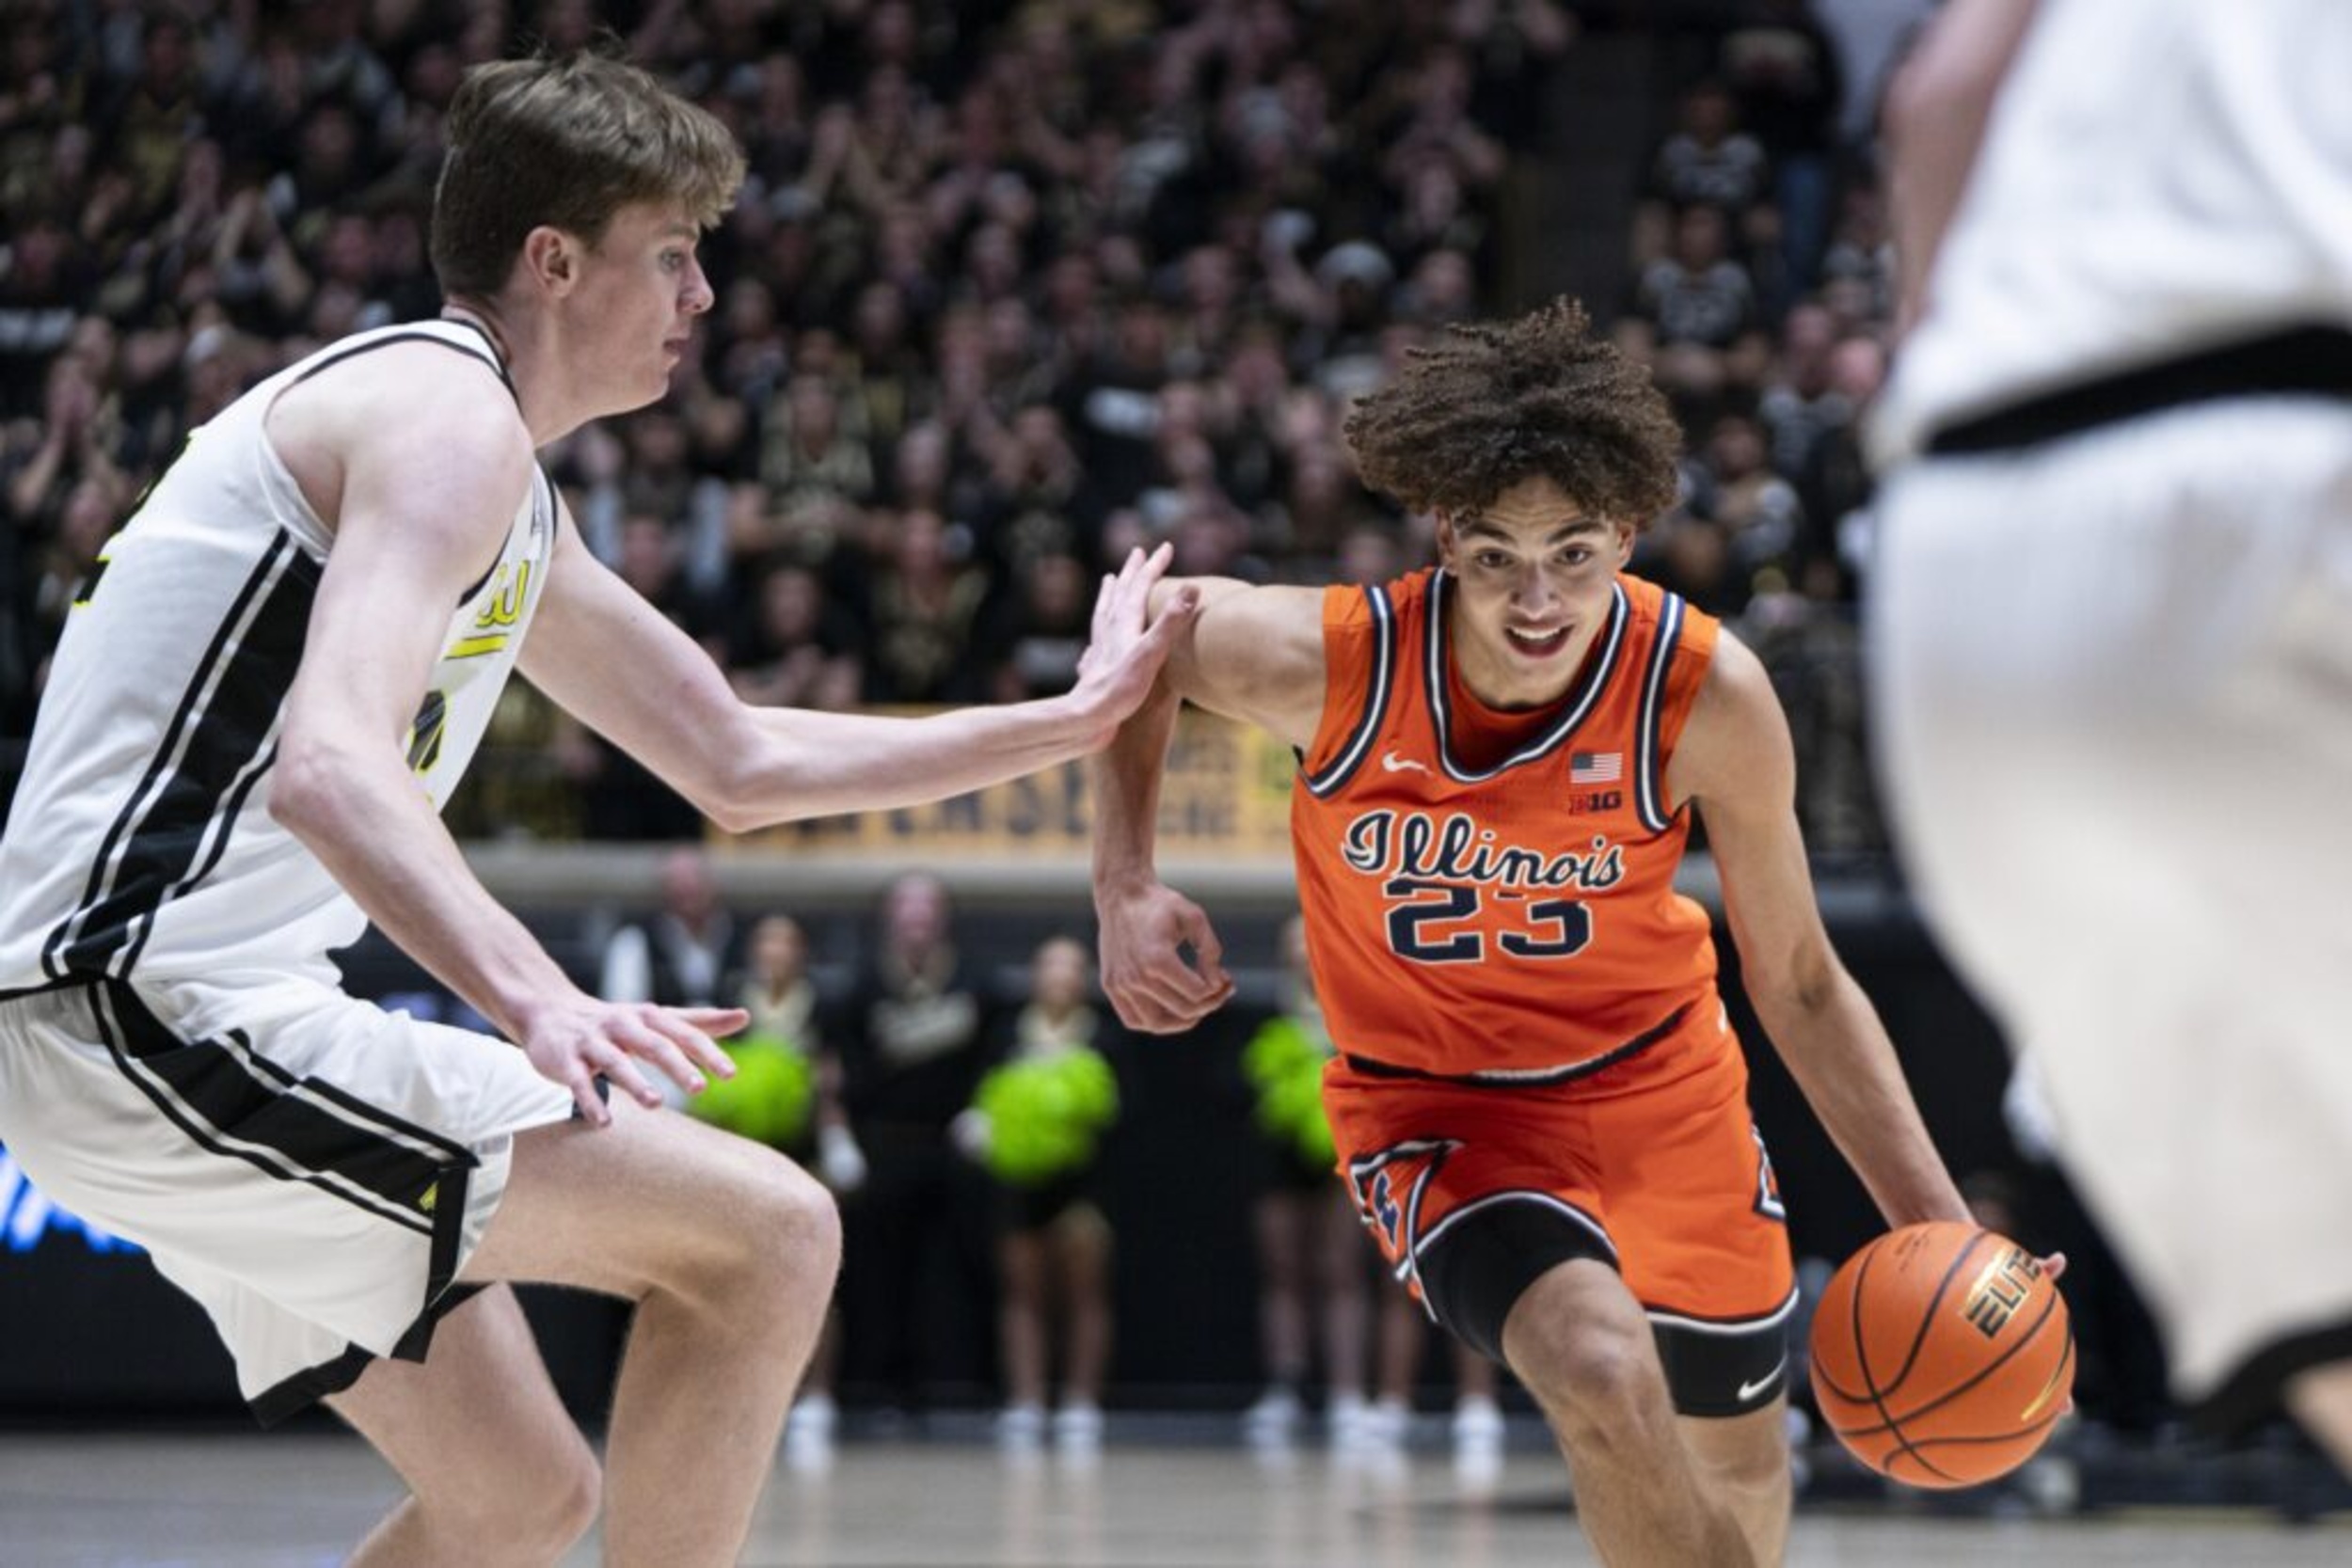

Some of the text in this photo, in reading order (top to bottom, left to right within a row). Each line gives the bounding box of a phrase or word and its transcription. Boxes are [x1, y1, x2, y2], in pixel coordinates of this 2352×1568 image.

[1341, 808, 1626, 891] Illinois
[1382, 877, 1593, 964] 23
[1966, 1246, 2042, 1339] ELITE
